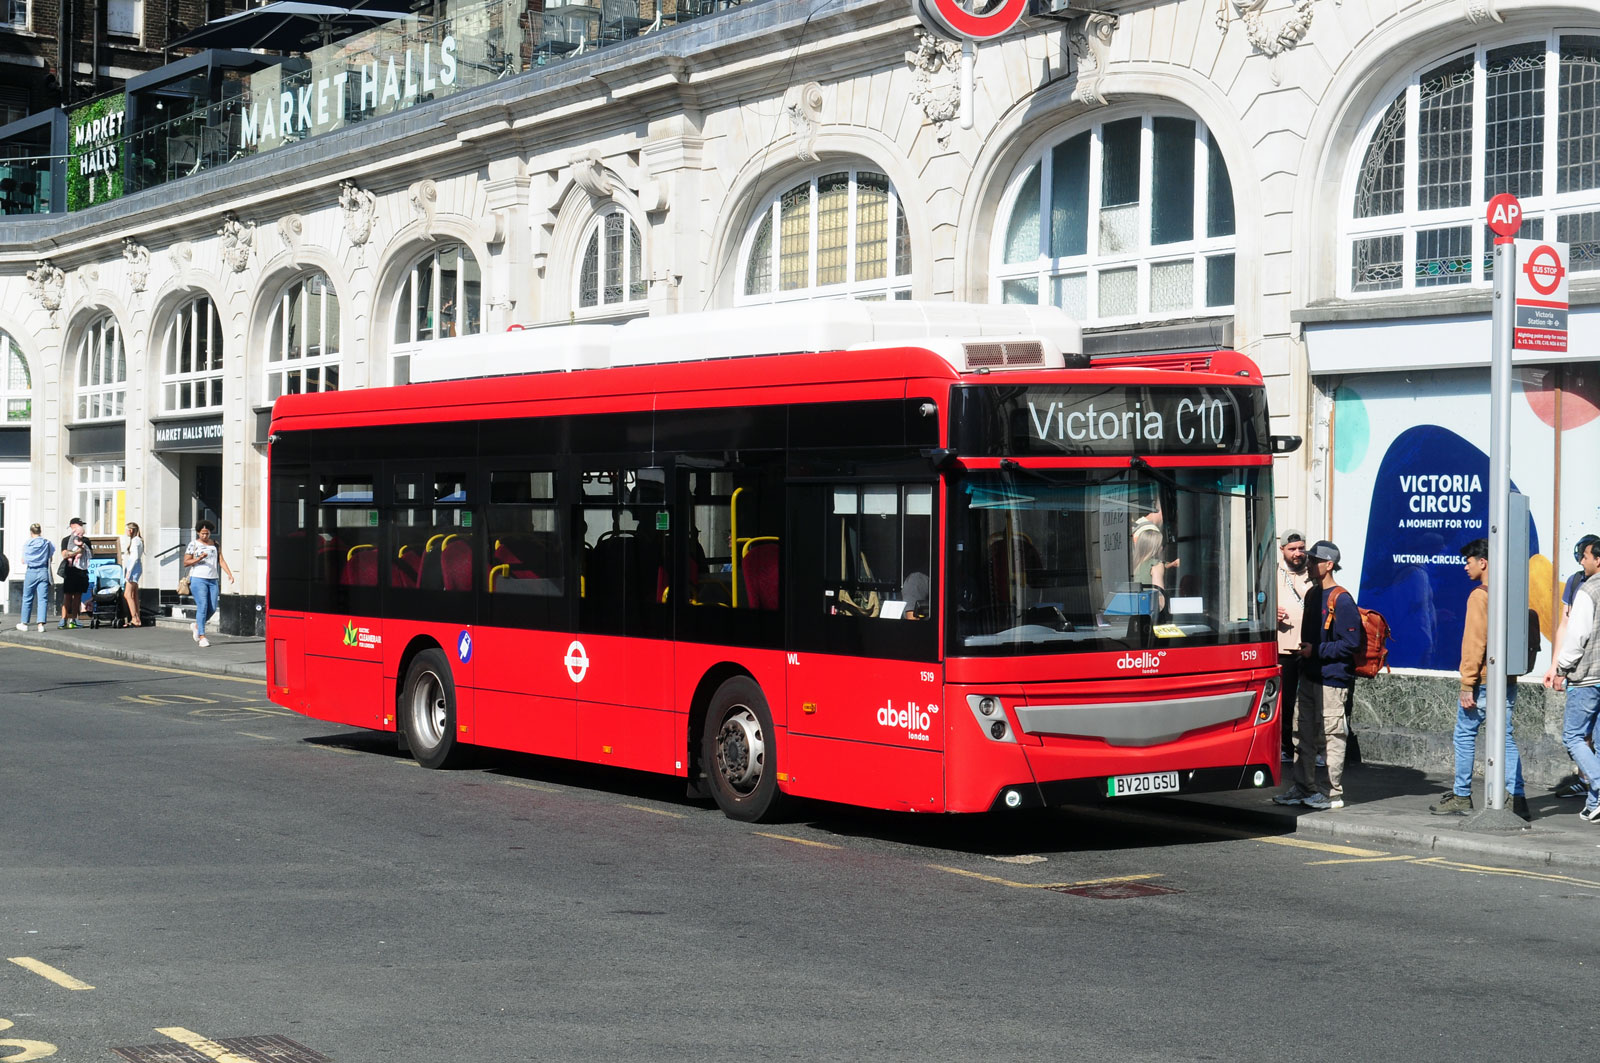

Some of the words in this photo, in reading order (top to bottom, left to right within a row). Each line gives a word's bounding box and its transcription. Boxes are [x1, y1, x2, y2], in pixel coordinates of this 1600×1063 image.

[240, 71, 348, 149] MARKET
[360, 35, 457, 111] HALLS
[75, 110, 124, 148] MARKET
[80, 144, 117, 176] HALLS
[1492, 204, 1519, 224] AP
[1532, 265, 1543, 273] BUS
[1543, 266, 1557, 274] STOP
[1528, 317, 1545, 325] Station
[1028, 401, 1163, 440] Victoria
[1176, 398, 1224, 444] C10
[156, 427, 181, 442] MARKET
[183, 426, 203, 440] HALLS
[1399, 474, 1482, 493] VICTORIA
[1409, 494, 1472, 513] CIRCUS
[1398, 519, 1405, 528] A
[1406, 519, 1443, 528] MOMENT
[1445, 519, 1462, 528] FOR
[1464, 519, 1482, 529] YOU
[787, 652, 800, 666] WL
[1116, 652, 1160, 669] abellio
[1240, 650, 1257, 661] 1519
[920, 670, 935, 682] 1519
[877, 699, 931, 731] abellio
[908, 731, 930, 742] london
[1117, 776, 1150, 793] BV20
[1153, 773, 1177, 790] GSU
